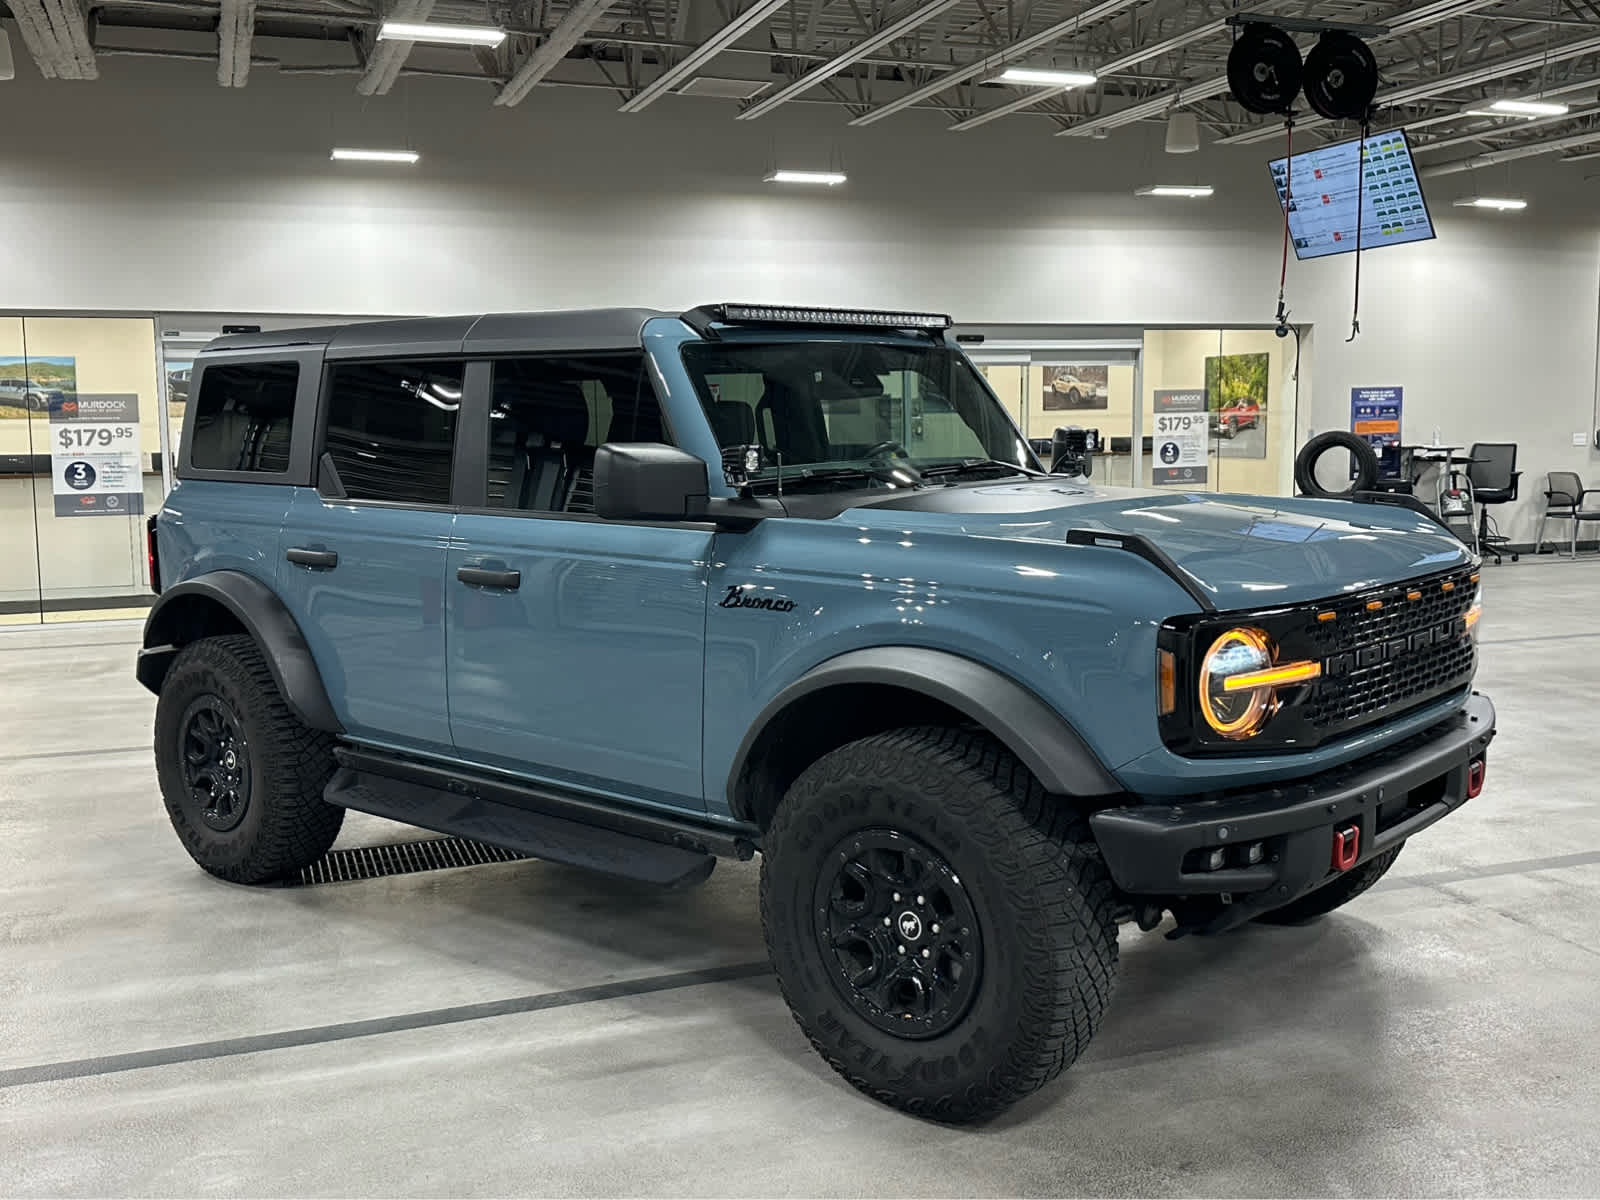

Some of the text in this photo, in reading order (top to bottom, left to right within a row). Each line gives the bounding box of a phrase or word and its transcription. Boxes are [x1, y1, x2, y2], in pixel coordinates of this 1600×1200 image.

[78, 400, 127, 409] MURDOCK
[1166, 444, 1174, 456] 3
[73, 464, 86, 480] 3
[719, 584, 798, 612] Bronco
